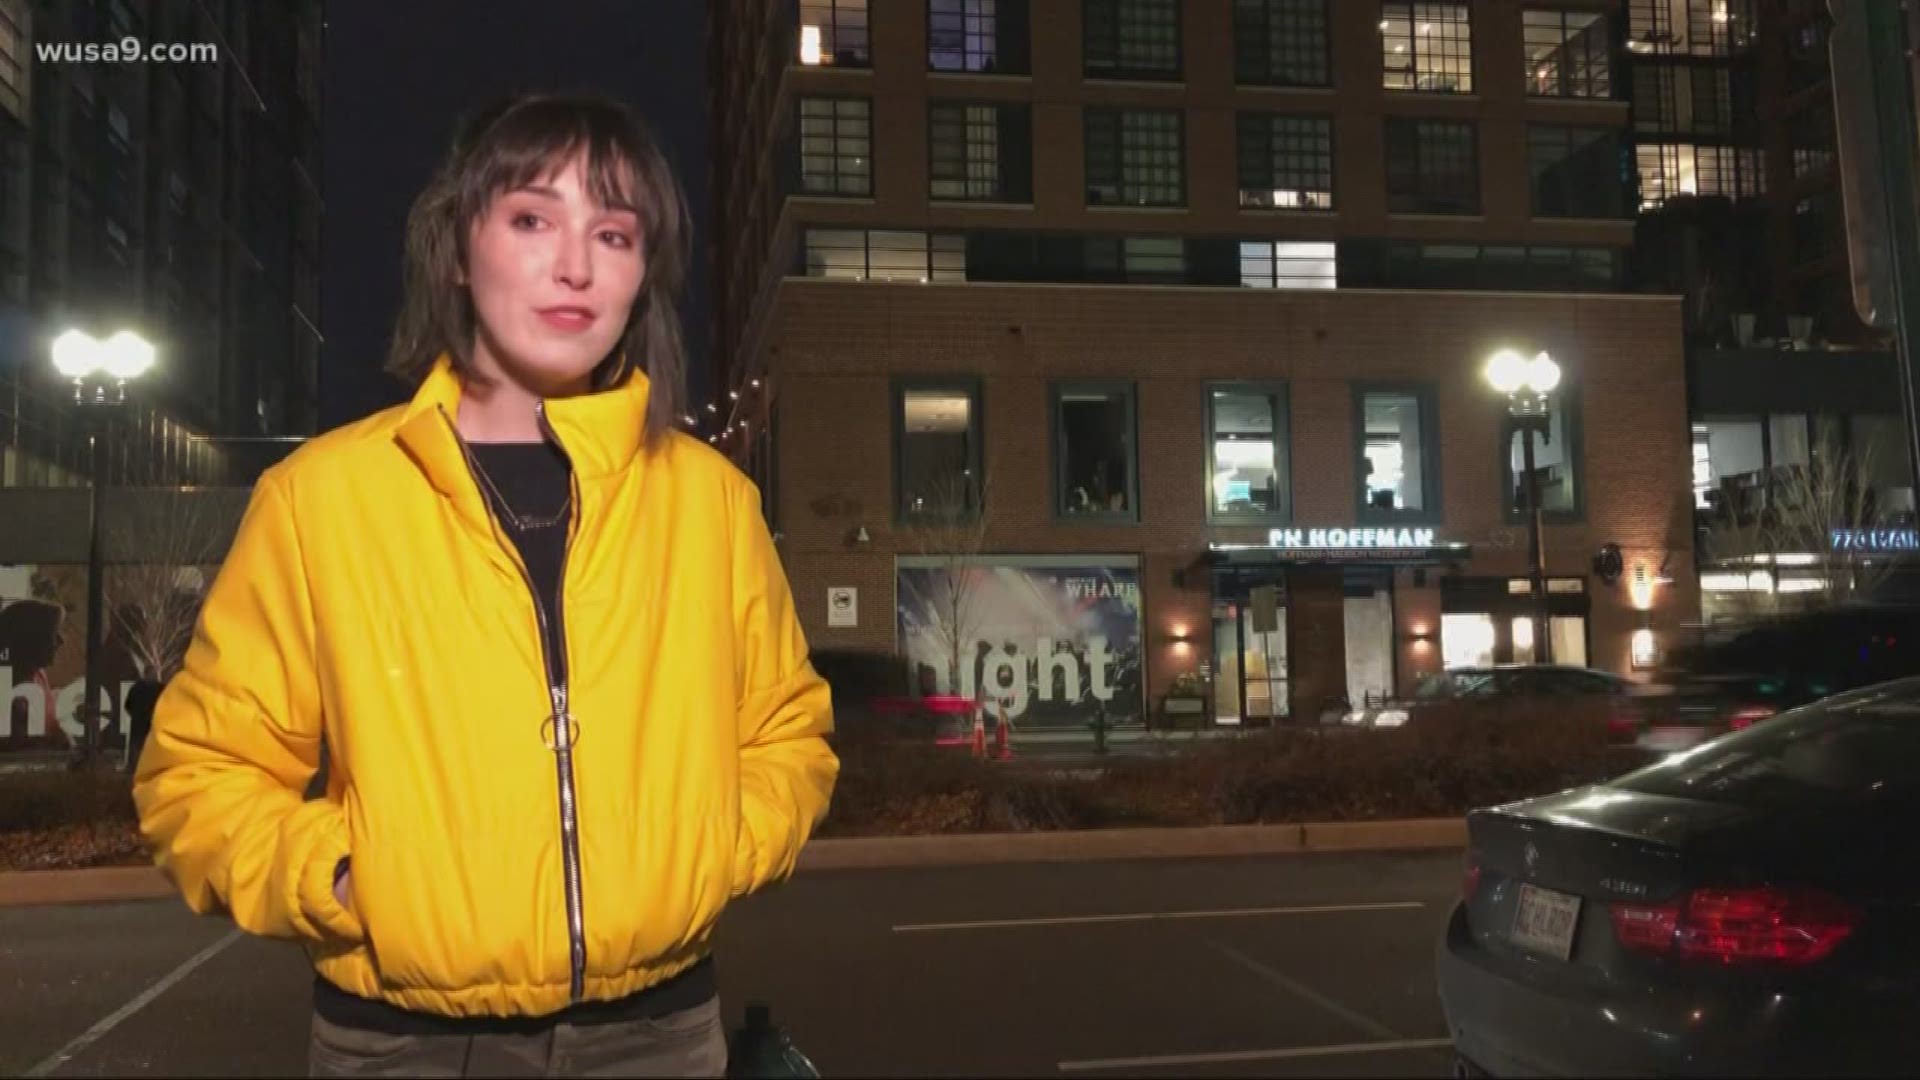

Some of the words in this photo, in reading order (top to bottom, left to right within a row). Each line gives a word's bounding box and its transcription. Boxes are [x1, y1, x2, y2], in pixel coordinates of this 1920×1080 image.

[1268, 528, 1303, 548] PN
[1309, 528, 1435, 548] HOFFMAN
[1870, 529, 1920, 548] MAI
[1064, 581, 1137, 598] WHARF
